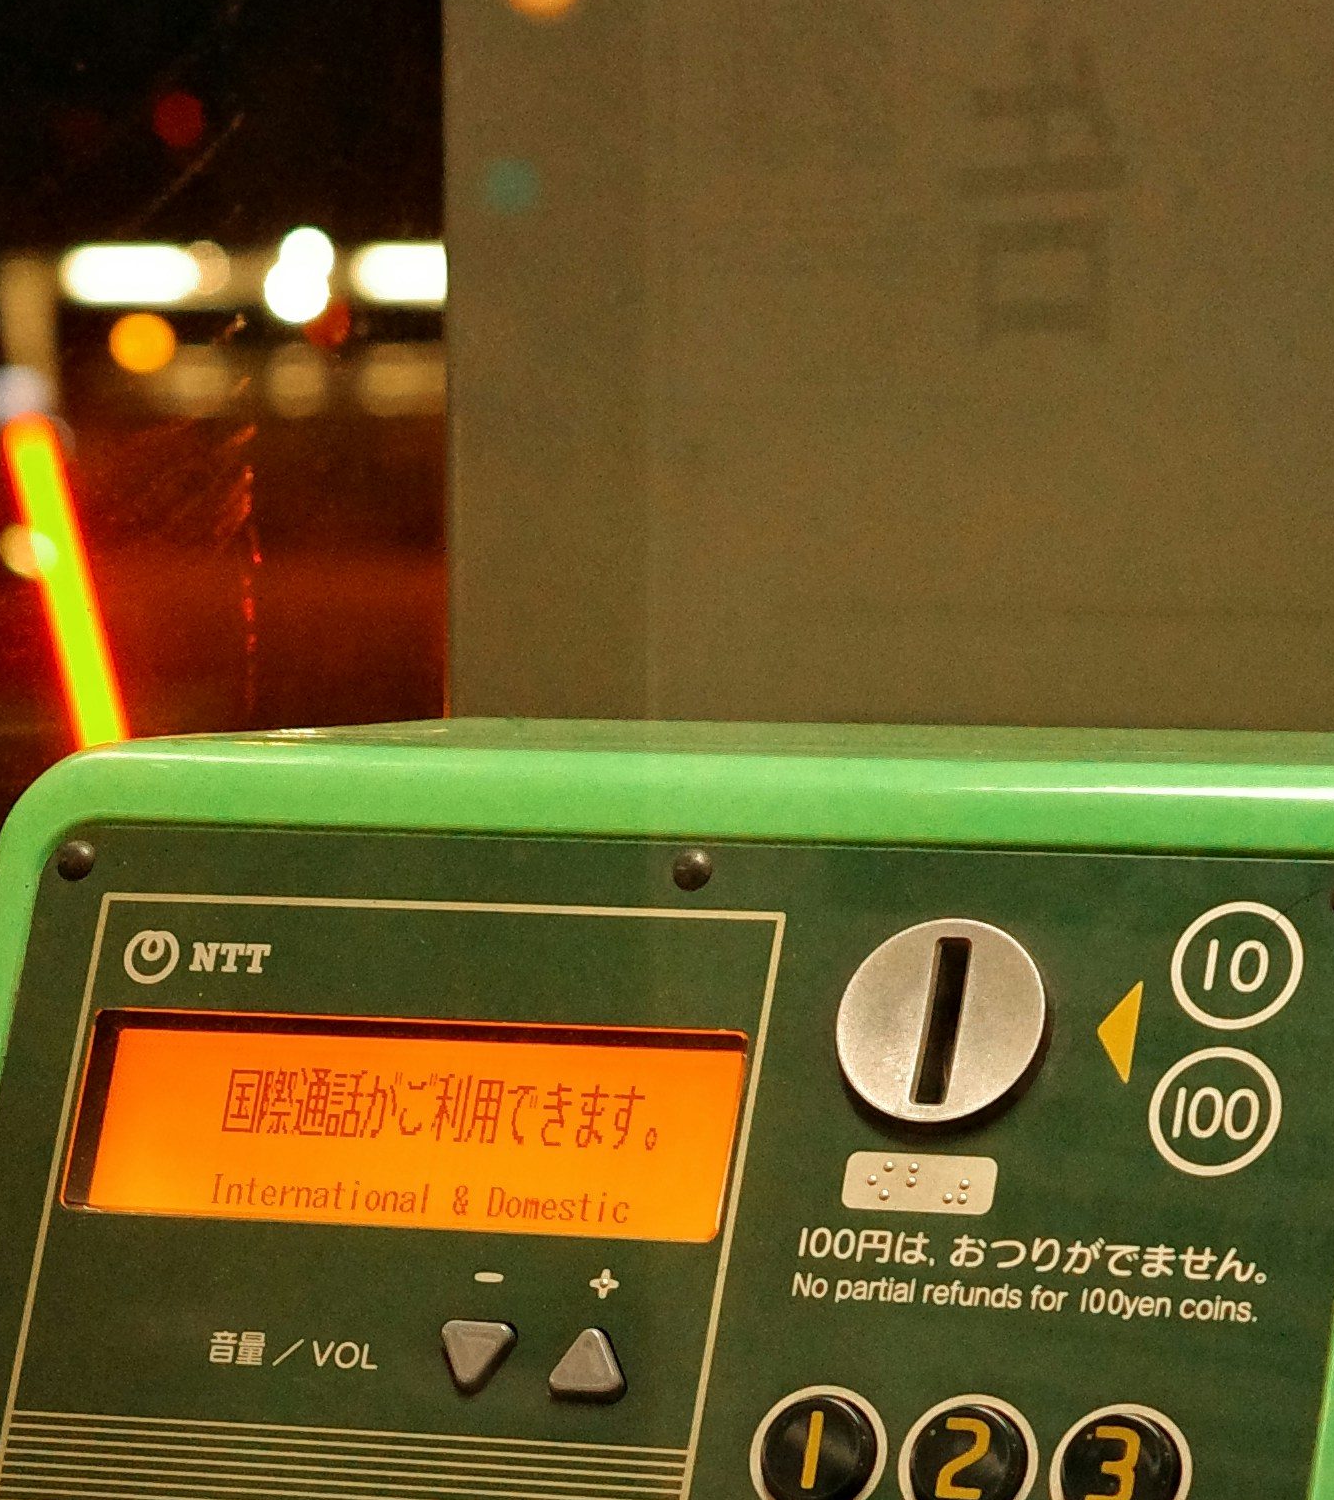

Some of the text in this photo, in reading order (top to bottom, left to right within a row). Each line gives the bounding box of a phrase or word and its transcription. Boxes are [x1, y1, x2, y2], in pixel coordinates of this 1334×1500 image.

[188, 942, 272, 975] NTT
[1202, 938, 1271, 993] 10
[221, 1066, 659, 1152] 国際通話がご利用できます。
[1171, 1086, 1261, 1141] 100
[210, 1174, 630, 1226] International & Domestic
[791, 1272, 1259, 1324] No partial refunds for 100yen coins.
[800, 1409, 825, 1491] 1
[934, 1416, 992, 1500] 2
